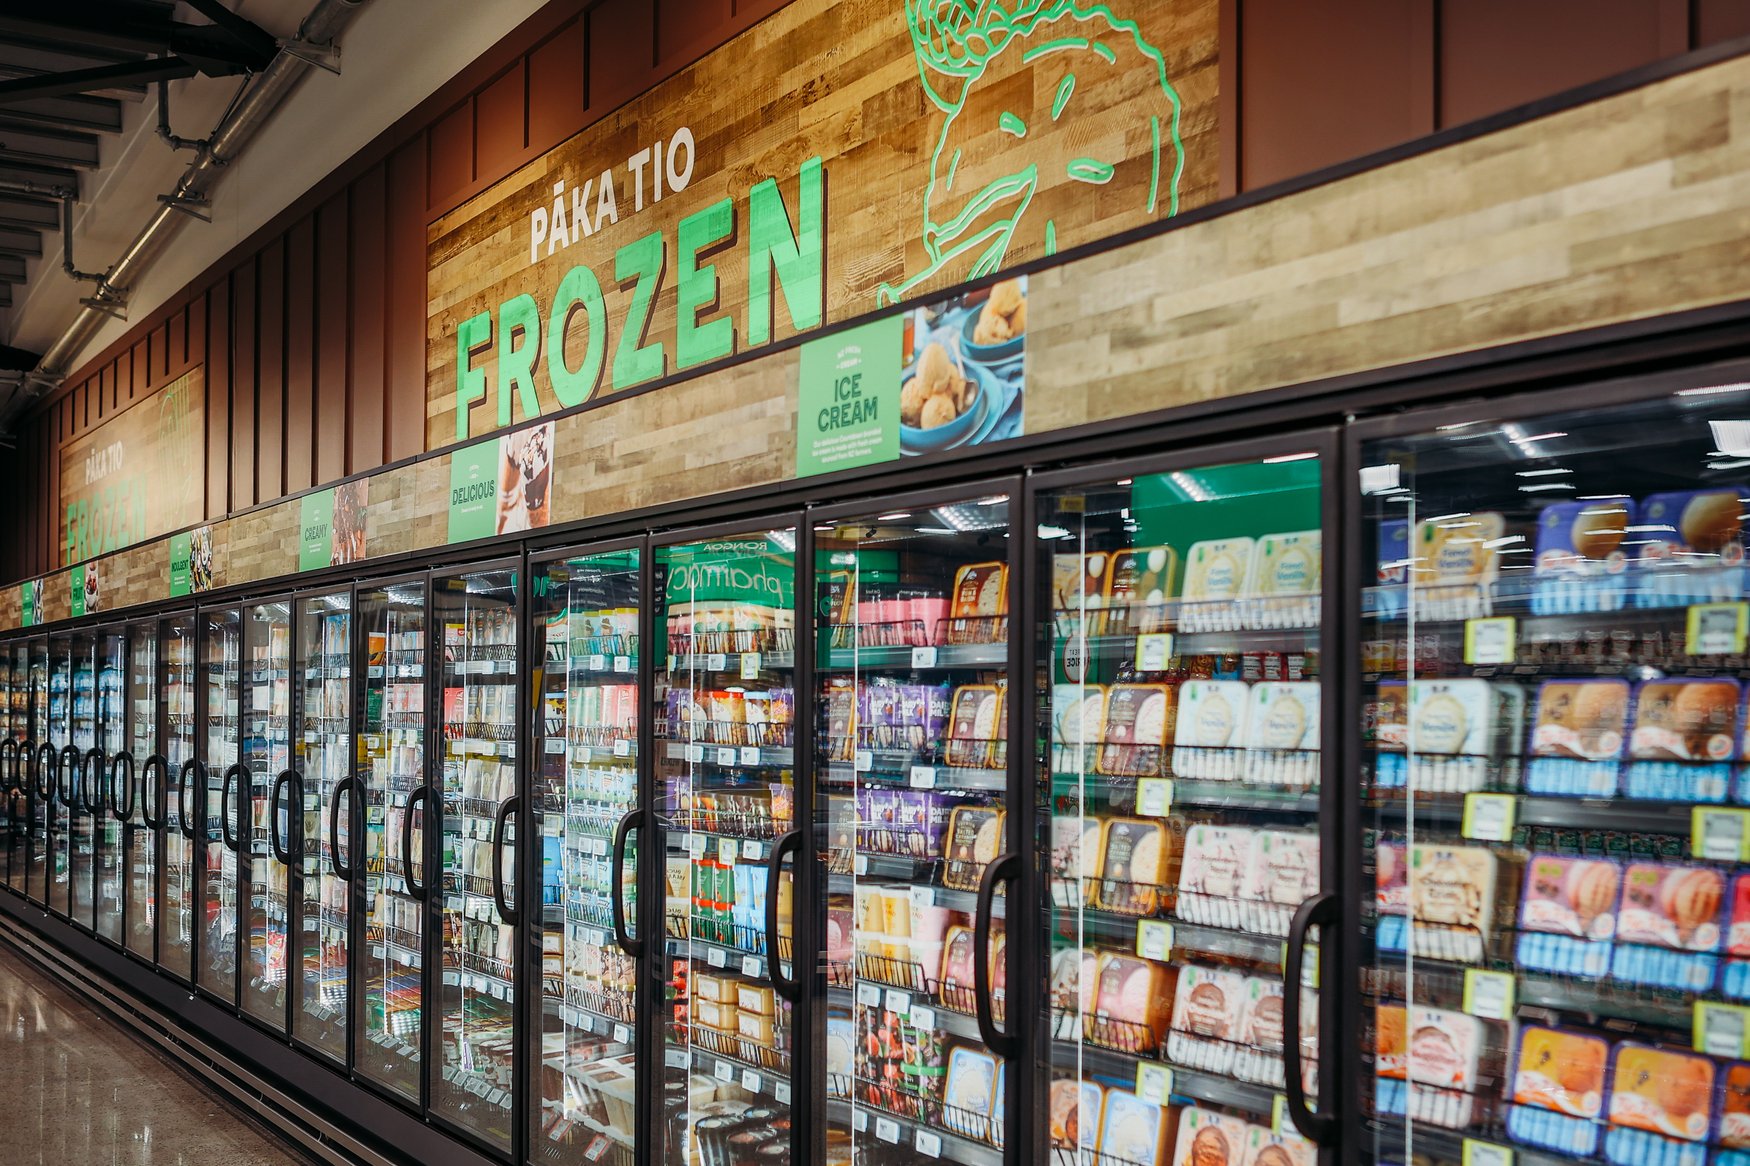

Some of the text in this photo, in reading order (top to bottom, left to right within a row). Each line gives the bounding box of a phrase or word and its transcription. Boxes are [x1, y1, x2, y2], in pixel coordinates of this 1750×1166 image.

[530, 126, 696, 264] PĀKA TIO
[456, 156, 828, 441] FROZEN
[834, 373, 863, 403] ICE
[817, 396, 879, 432] CREAM
[452, 479, 495, 506] DELICIOUS
[66, 468, 147, 567] FROZEN
[304, 523, 329, 542] CREAMY
